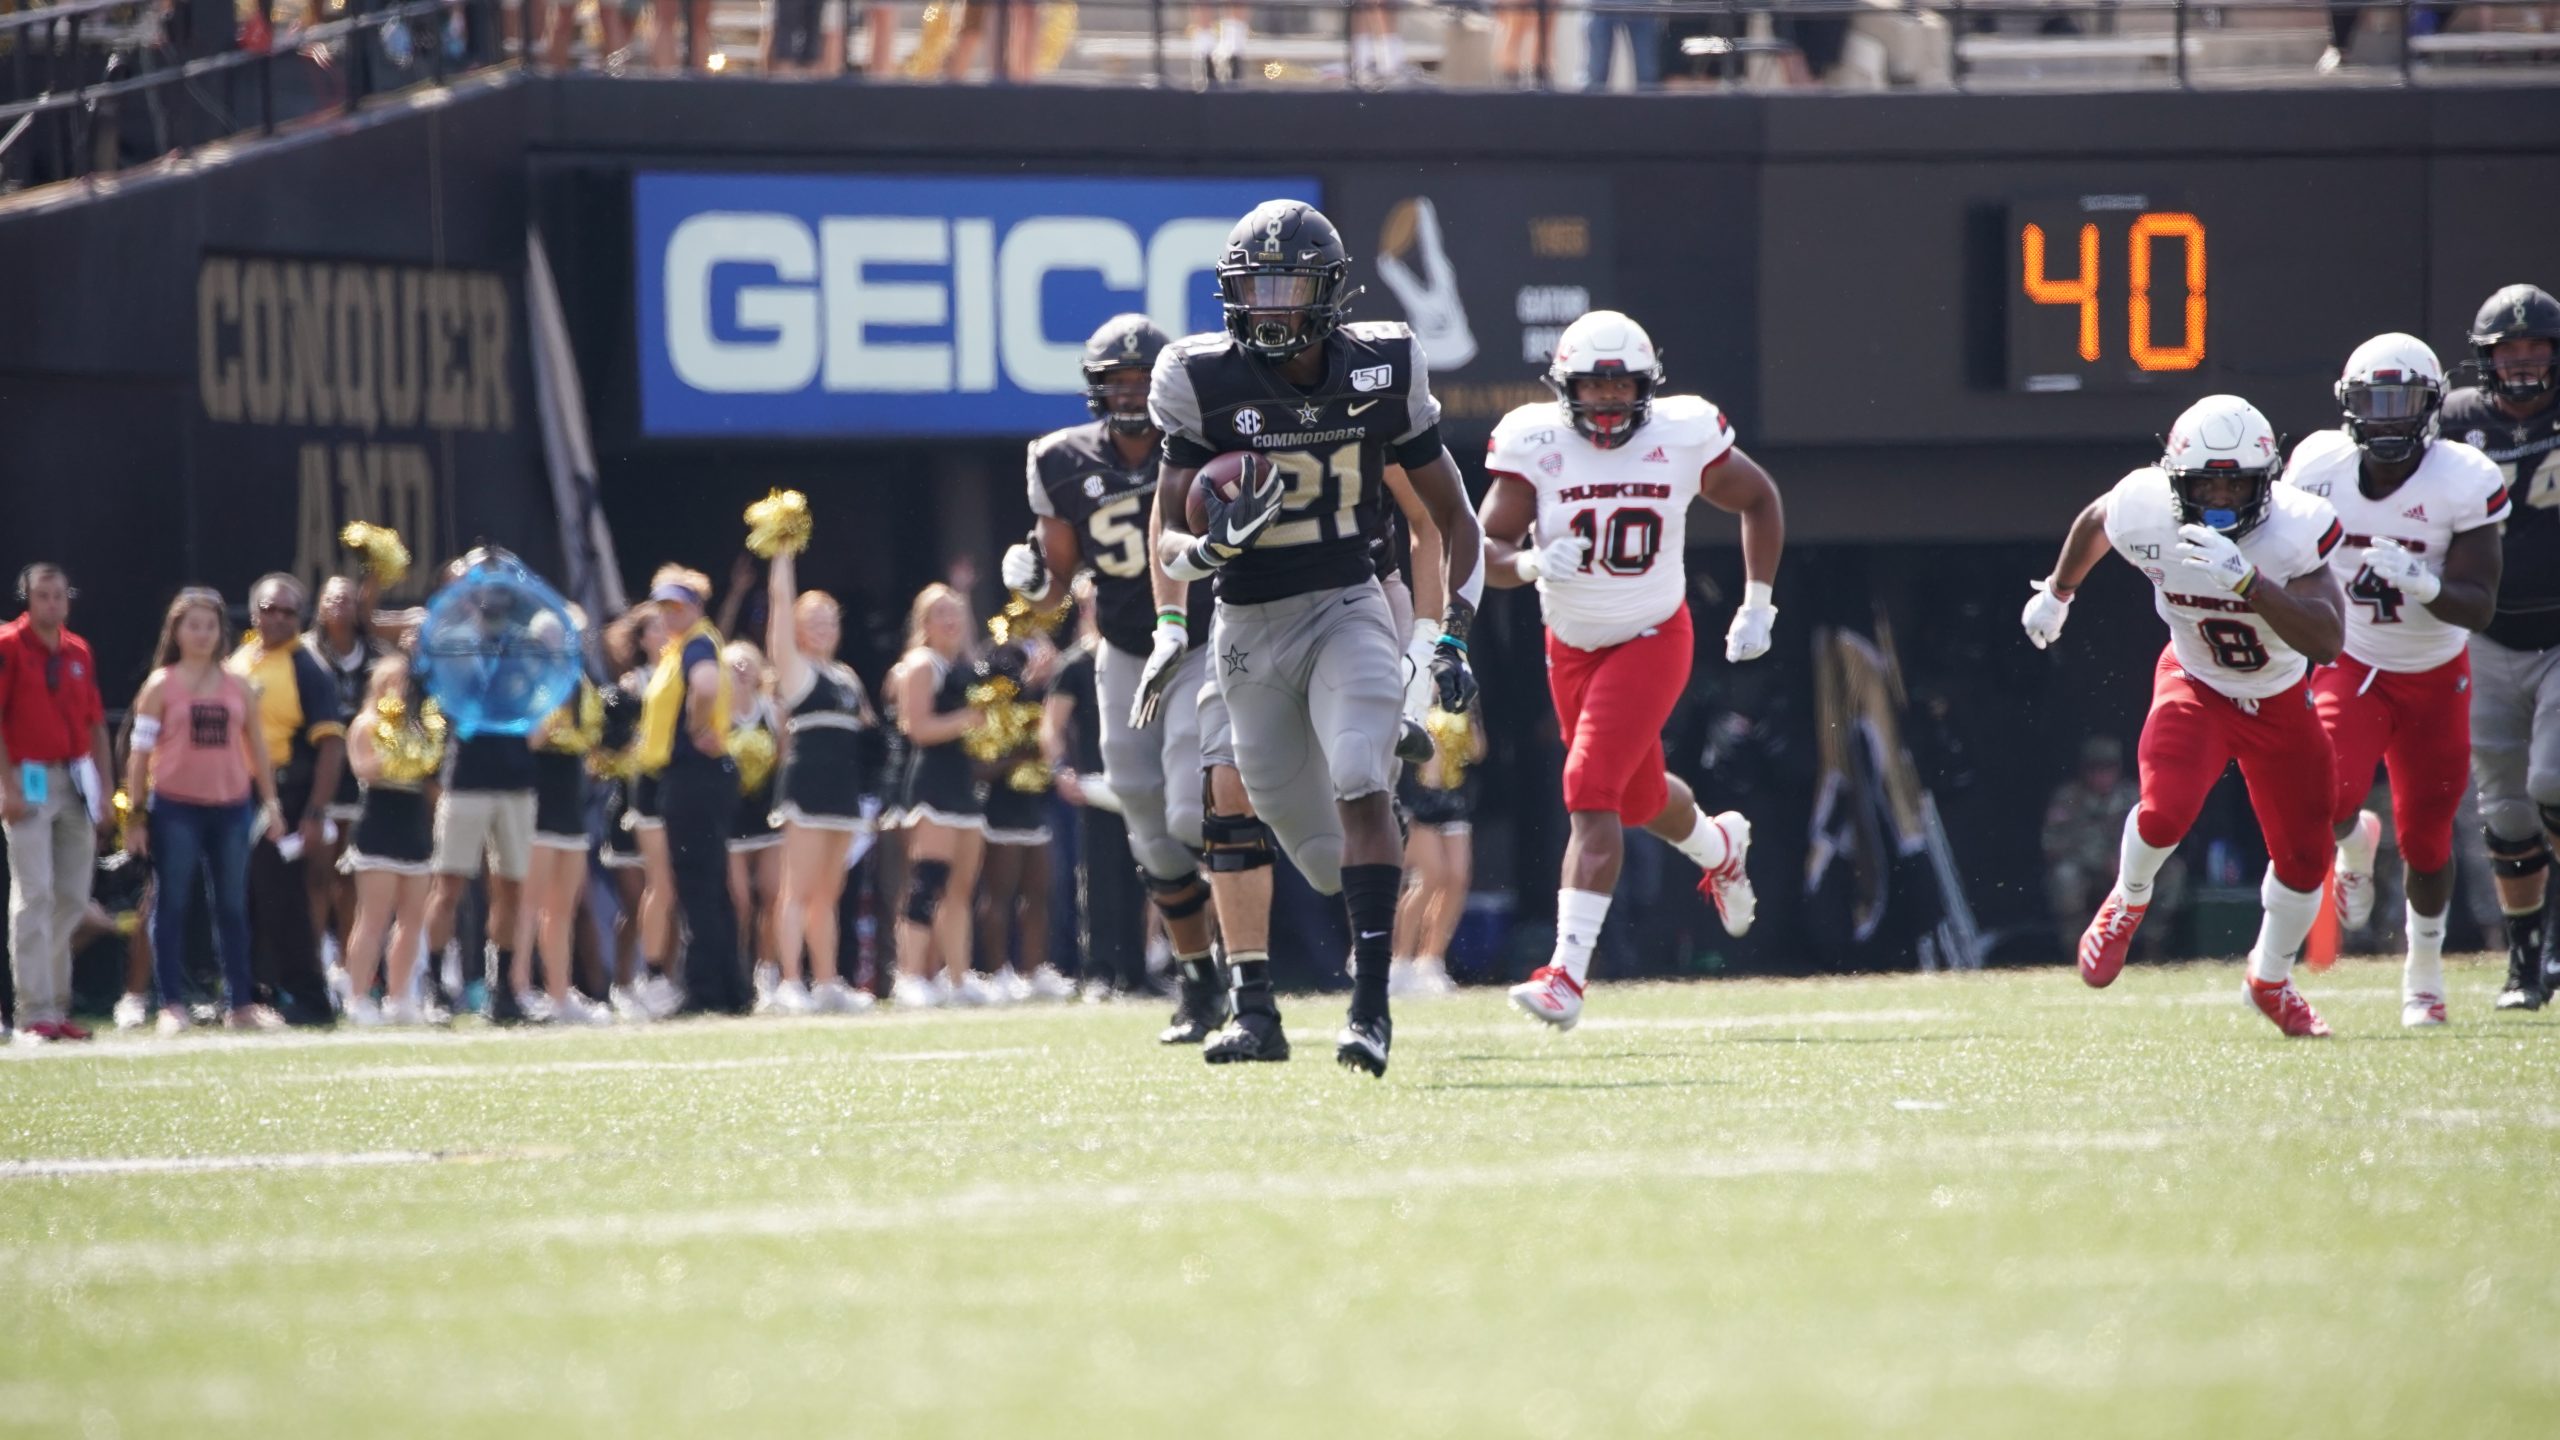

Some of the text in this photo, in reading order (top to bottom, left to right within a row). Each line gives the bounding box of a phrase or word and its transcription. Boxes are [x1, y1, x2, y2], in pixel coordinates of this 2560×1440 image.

[2021, 212, 2206, 371] 40
[198, 256, 514, 434] CONQUER
[1353, 366, 1390, 390] 150
[1235, 408, 1262, 434] SEC
[1253, 427, 1366, 448] COMMODORES
[294, 442, 434, 600] AND
[1252, 441, 1362, 549] 21
[1559, 482, 1672, 504] HUSKIES
[1570, 507, 1663, 576] 10
[2345, 563, 2404, 625] 4
[2197, 617, 2270, 672] 8
